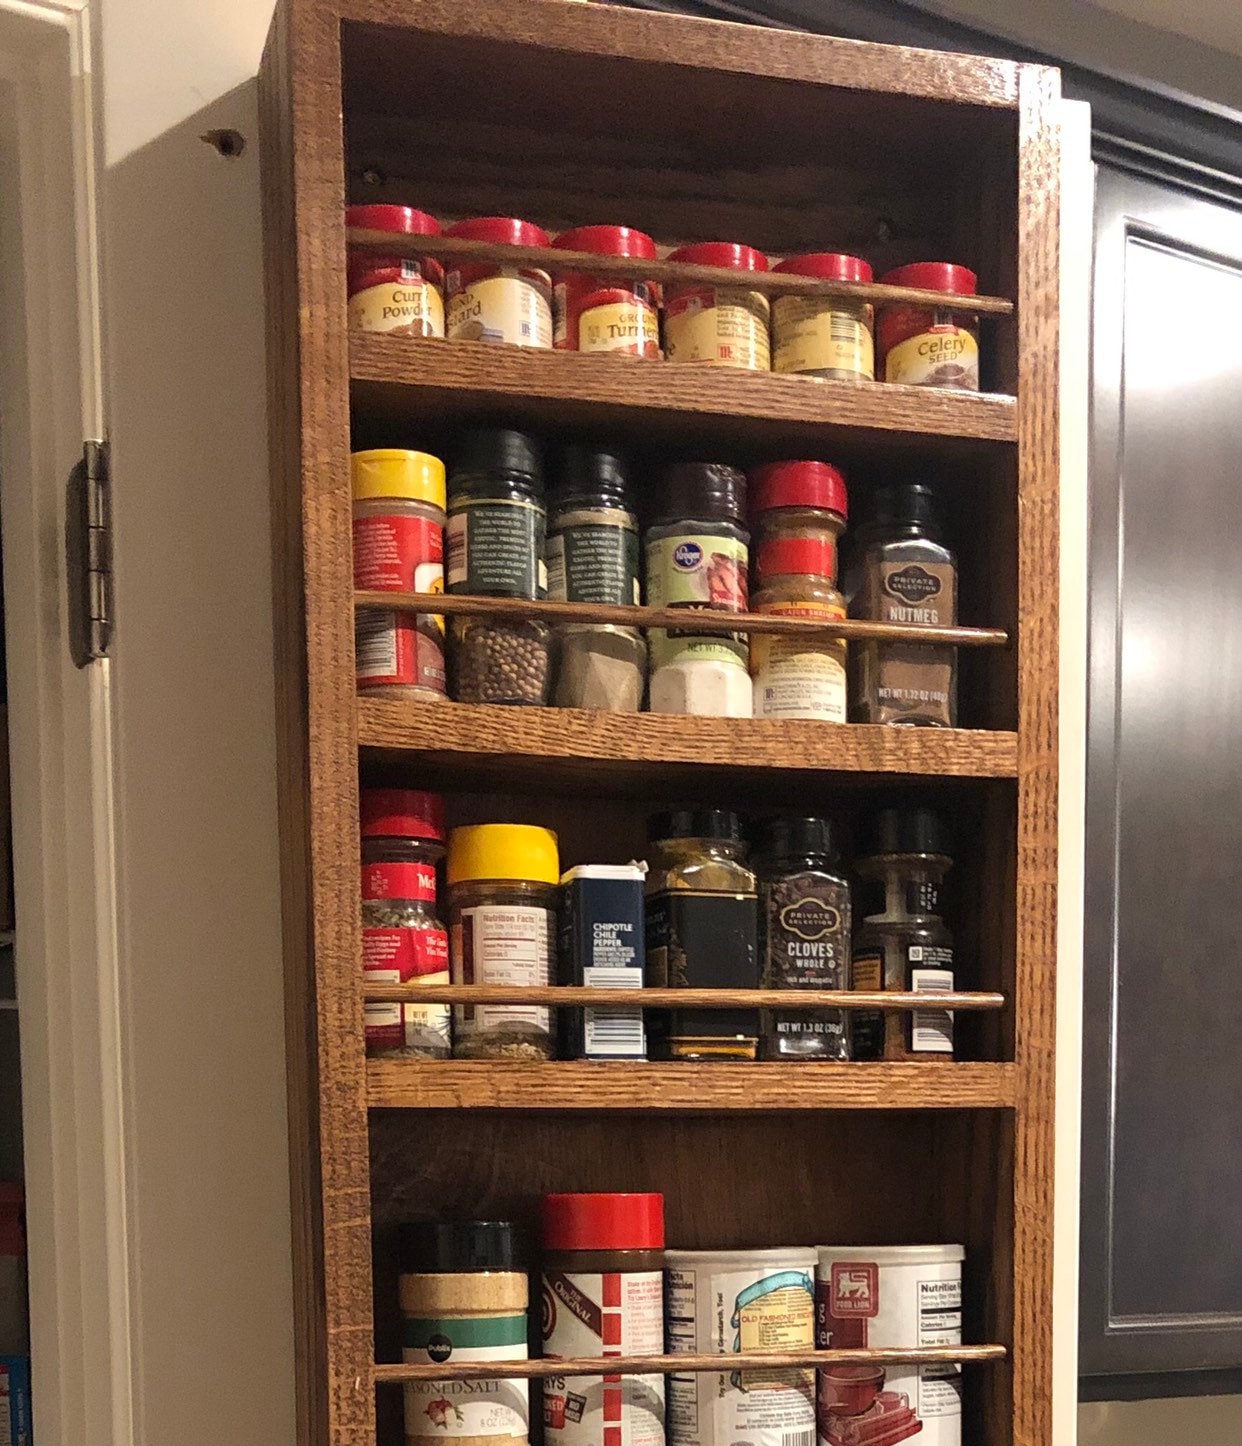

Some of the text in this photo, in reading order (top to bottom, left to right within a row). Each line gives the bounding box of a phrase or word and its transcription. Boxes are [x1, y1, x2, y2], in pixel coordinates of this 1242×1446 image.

[392, 290, 430, 304] Curr
[382, 303, 433, 320] Powdr
[917, 337, 967, 356] Celery
[929, 351, 958, 365] SEED
[893, 576, 935, 586] PRIVATE
[892, 583, 937, 592] SELECTION
[889, 606, 939, 624] NUTMEG
[790, 912, 831, 921] PRIVATE
[592, 922, 634, 933] CHIPOTLE
[592, 931, 618, 940] CHILE
[592, 938, 623, 948] PEPPER
[786, 941, 835, 958] CLOVES
[795, 958, 826, 969] WHOLE
[777, 1022, 790, 1032] NET
[791, 1022, 801, 1032] WT
[815, 1023, 824, 1033] OZ
[920, 1283, 957, 1293] Nutrition
[554, 1280, 593, 1323] ORIGINAL
[837, 1301, 852, 1310] FOOD
[741, 1315, 758, 1324] OLD
